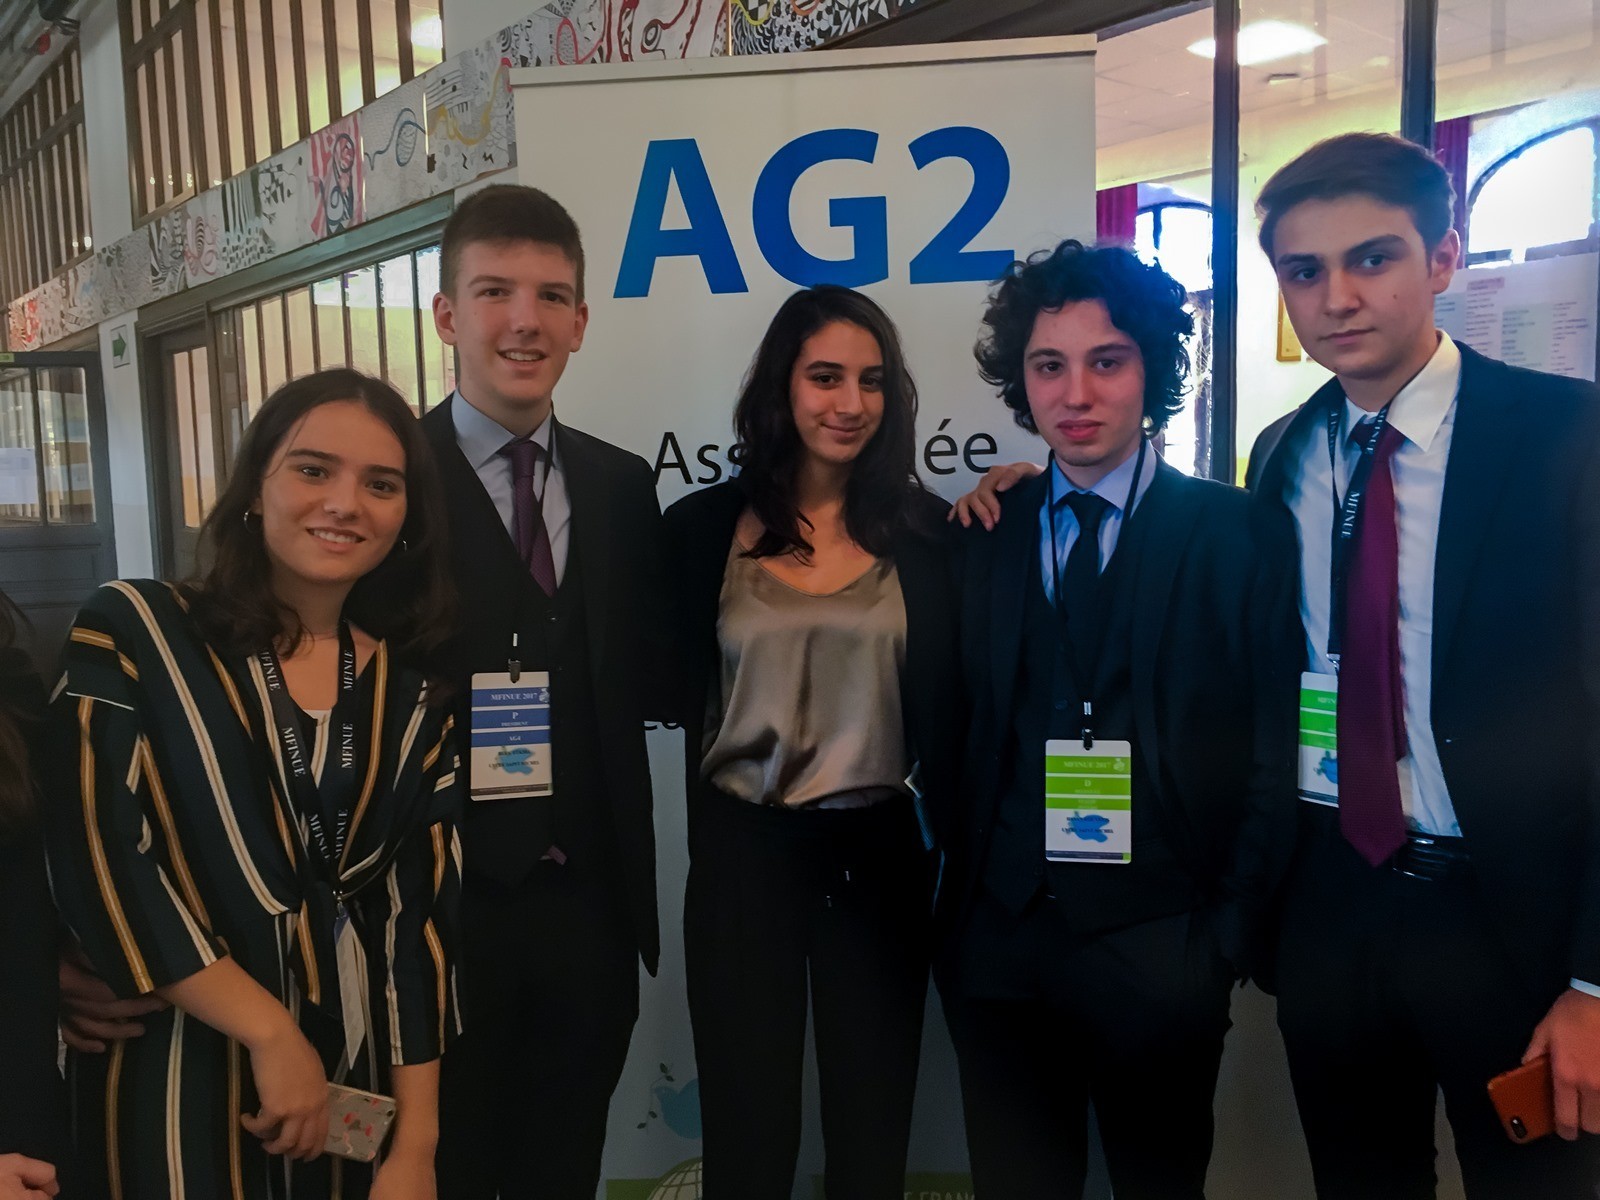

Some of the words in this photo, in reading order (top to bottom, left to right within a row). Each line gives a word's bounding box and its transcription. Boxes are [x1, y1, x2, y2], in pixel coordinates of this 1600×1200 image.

[613, 126, 1015, 299] AG2
[343, 649, 354, 691] MFINUE
[281, 726, 306, 778] MFINUE
[341, 722, 354, 769] MFINUE
